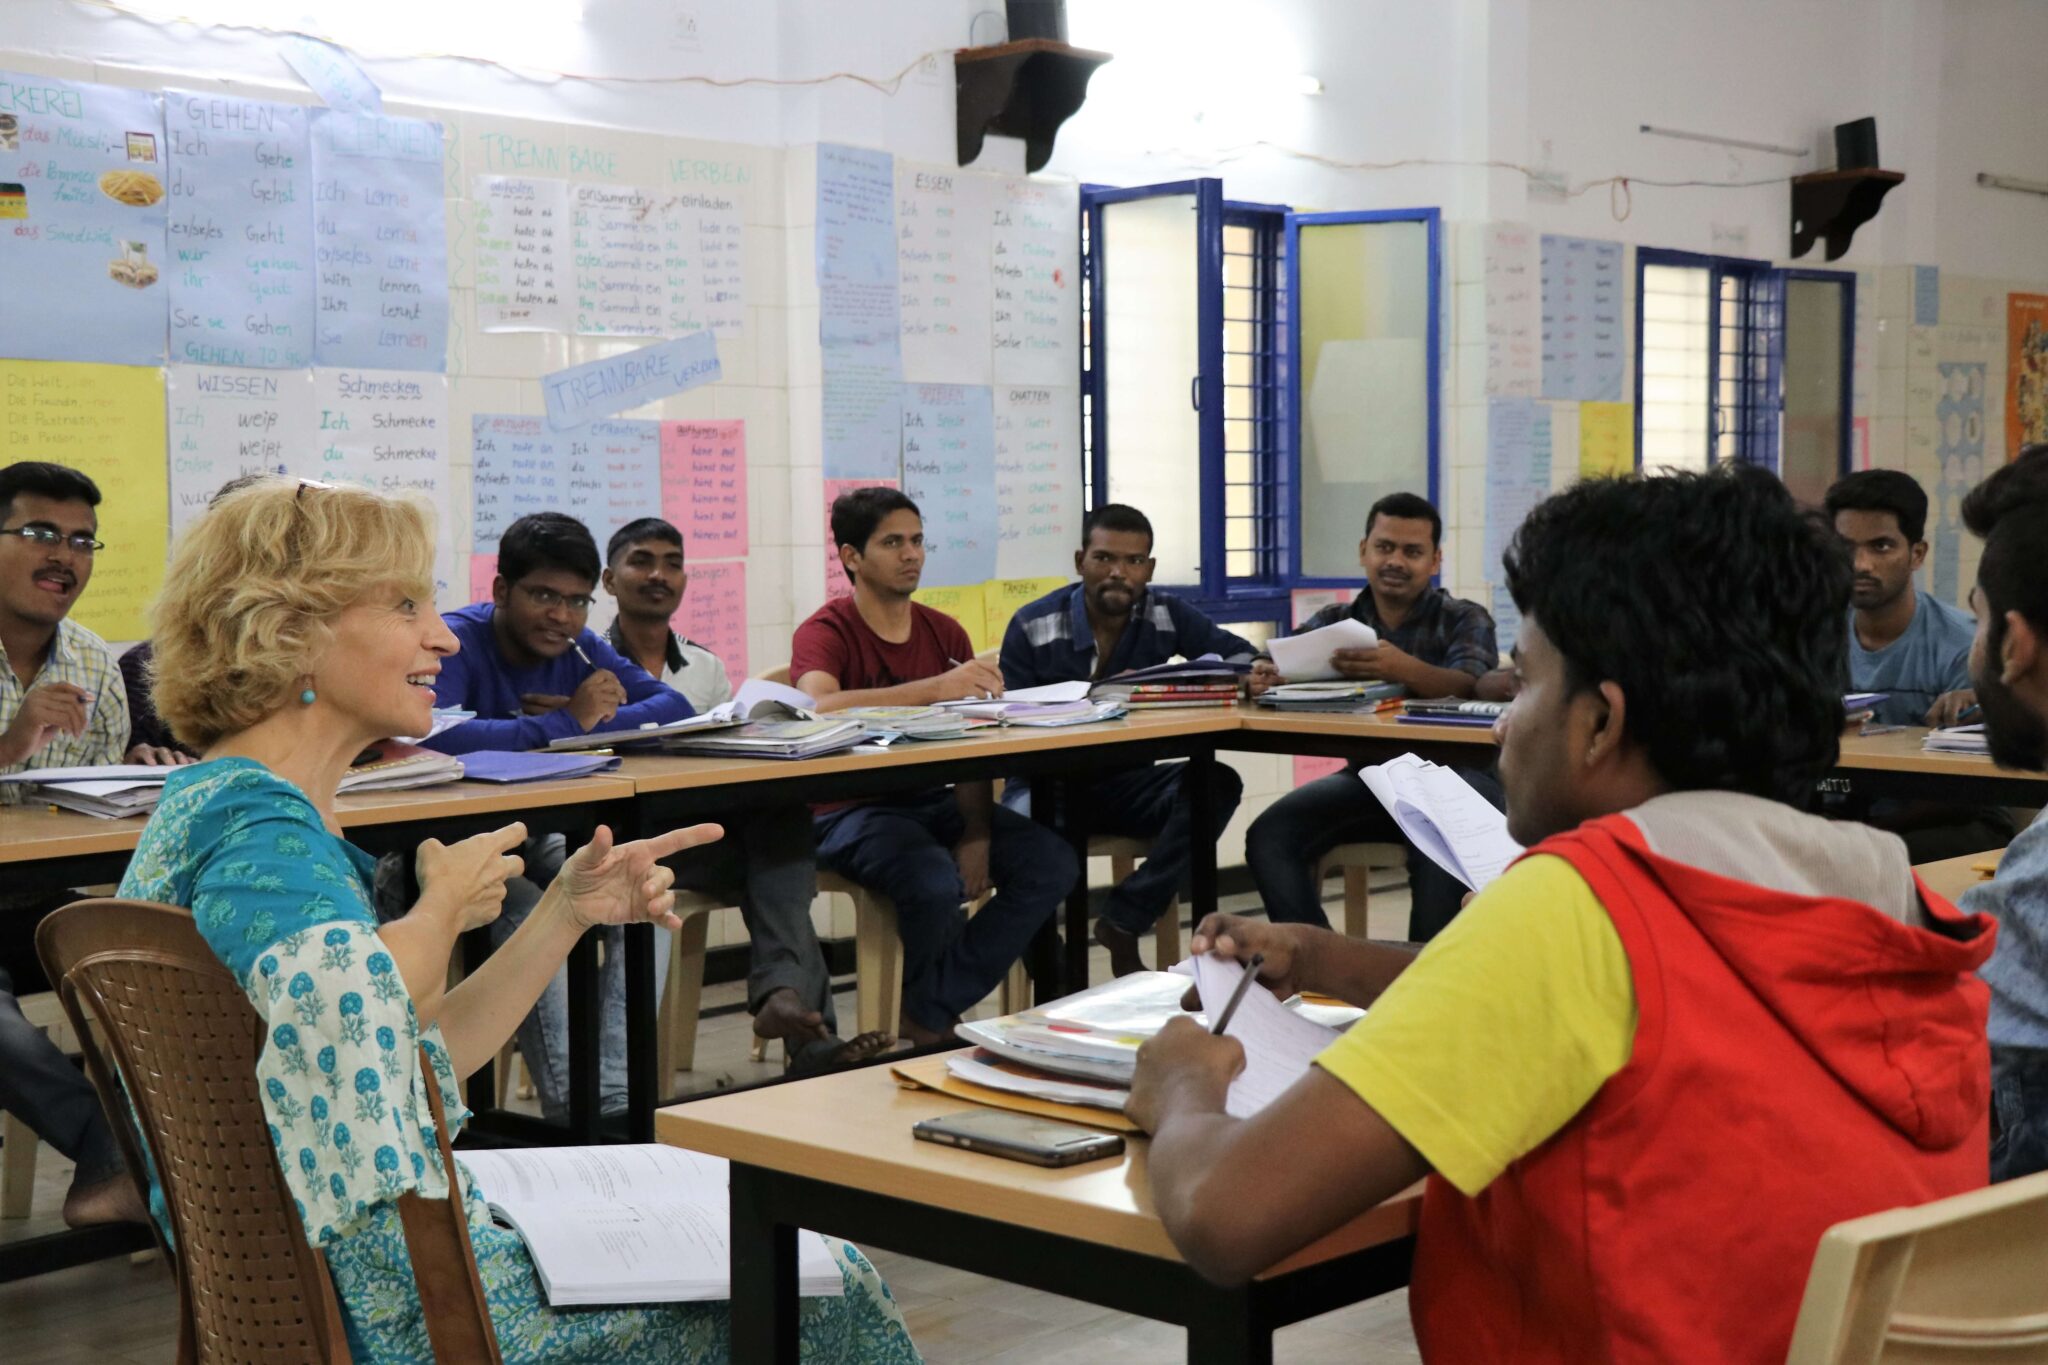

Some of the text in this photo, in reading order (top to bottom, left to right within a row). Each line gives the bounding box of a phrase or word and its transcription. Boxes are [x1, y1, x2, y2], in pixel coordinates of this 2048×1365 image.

[186, 98, 274, 132] GEHEN
[172, 129, 208, 156] Ich
[172, 167, 196, 197] du
[316, 179, 346, 203] Ich
[915, 172, 953, 191] ESSEN
[317, 216, 337, 236] du
[197, 372, 279, 396] WISSEN
[338, 372, 422, 395] Schmecken
[551, 353, 672, 415] TRENNBARE
[1009, 388, 1051, 402] CHATTEN
[319, 409, 351, 432] Ich
[322, 442, 345, 463] du
